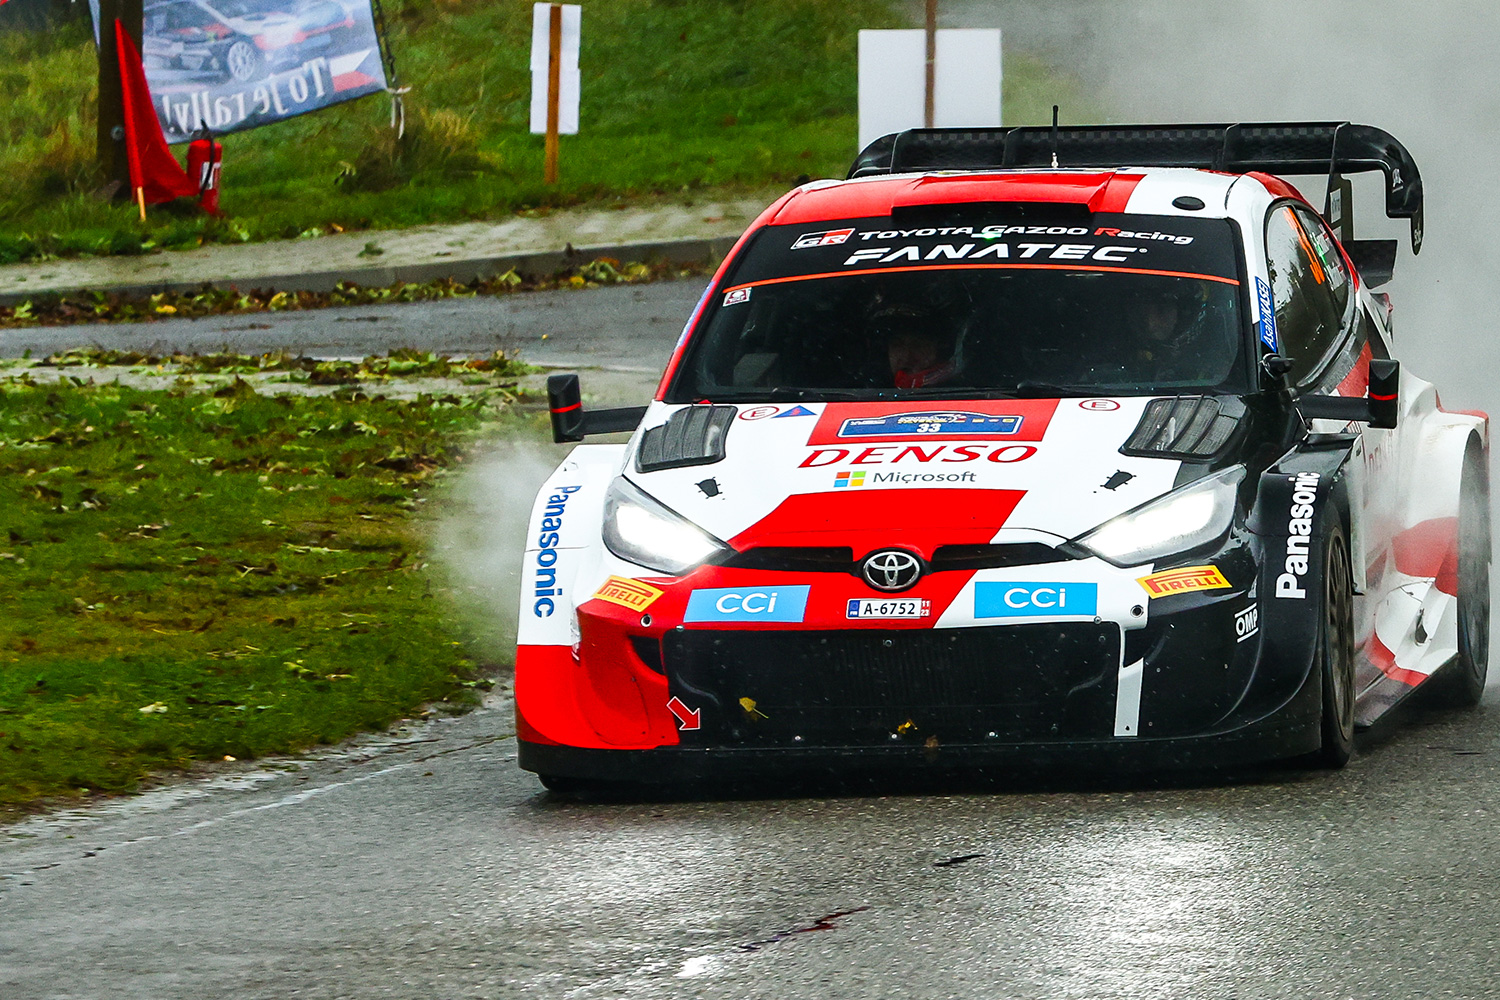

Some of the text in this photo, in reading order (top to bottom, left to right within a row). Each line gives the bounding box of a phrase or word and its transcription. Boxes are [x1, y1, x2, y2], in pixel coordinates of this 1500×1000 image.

[794, 225, 1194, 248] GR TOYOTA GAZOO Racing
[843, 243, 1139, 266] FANATEC
[1257, 278, 1275, 350] AsahiKASEI
[916, 423, 943, 433] 33
[797, 445, 1038, 469] DENSO
[873, 471, 977, 483] Microsoft
[1275, 472, 1321, 599] Panasonic
[533, 485, 582, 618] Panasonic
[597, 579, 654, 606] PIRELLI
[1144, 570, 1222, 593] PIRELLI
[863, 602, 916, 615] A-6752
[1235, 608, 1258, 636] OMP
